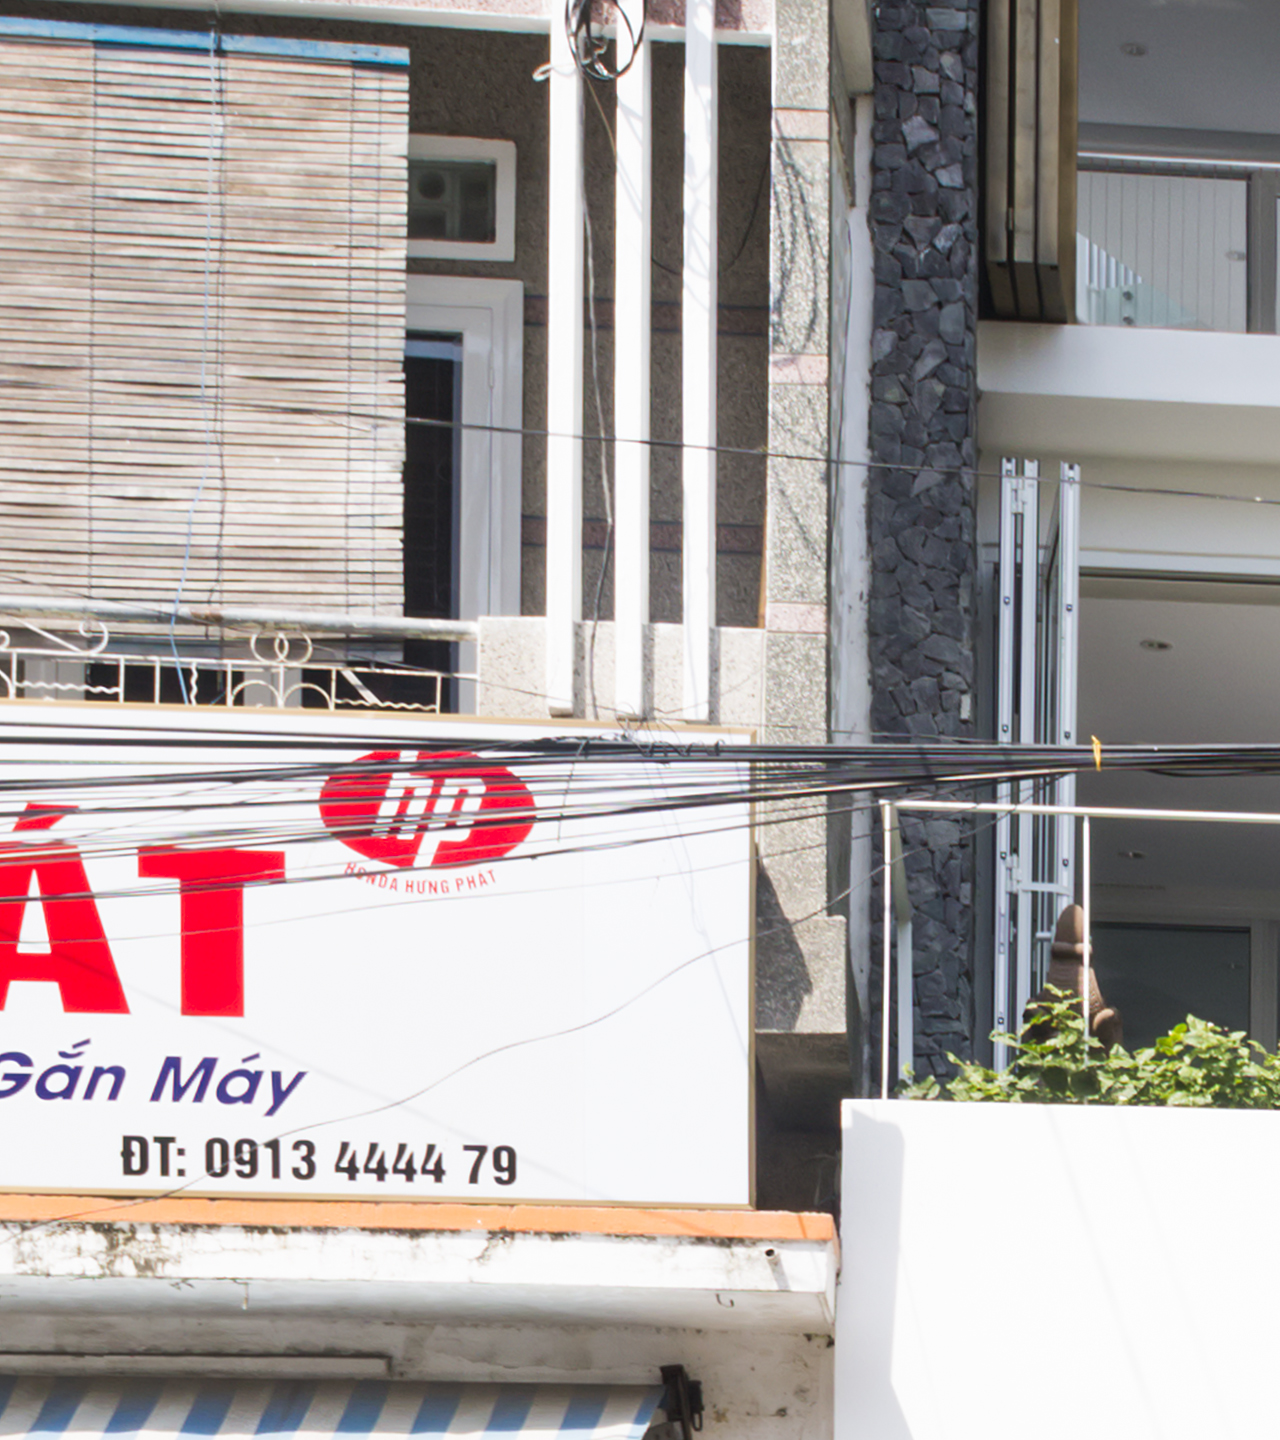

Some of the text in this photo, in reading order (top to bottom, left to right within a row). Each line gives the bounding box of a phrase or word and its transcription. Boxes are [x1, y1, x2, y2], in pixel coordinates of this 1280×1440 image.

[344, 862, 399, 892] HONDA
[455, 869, 497, 892] PHÁT
[149, 1052, 309, 1117] Máy
[120, 1134, 517, 1186] ĐT: 0913 4444 79
